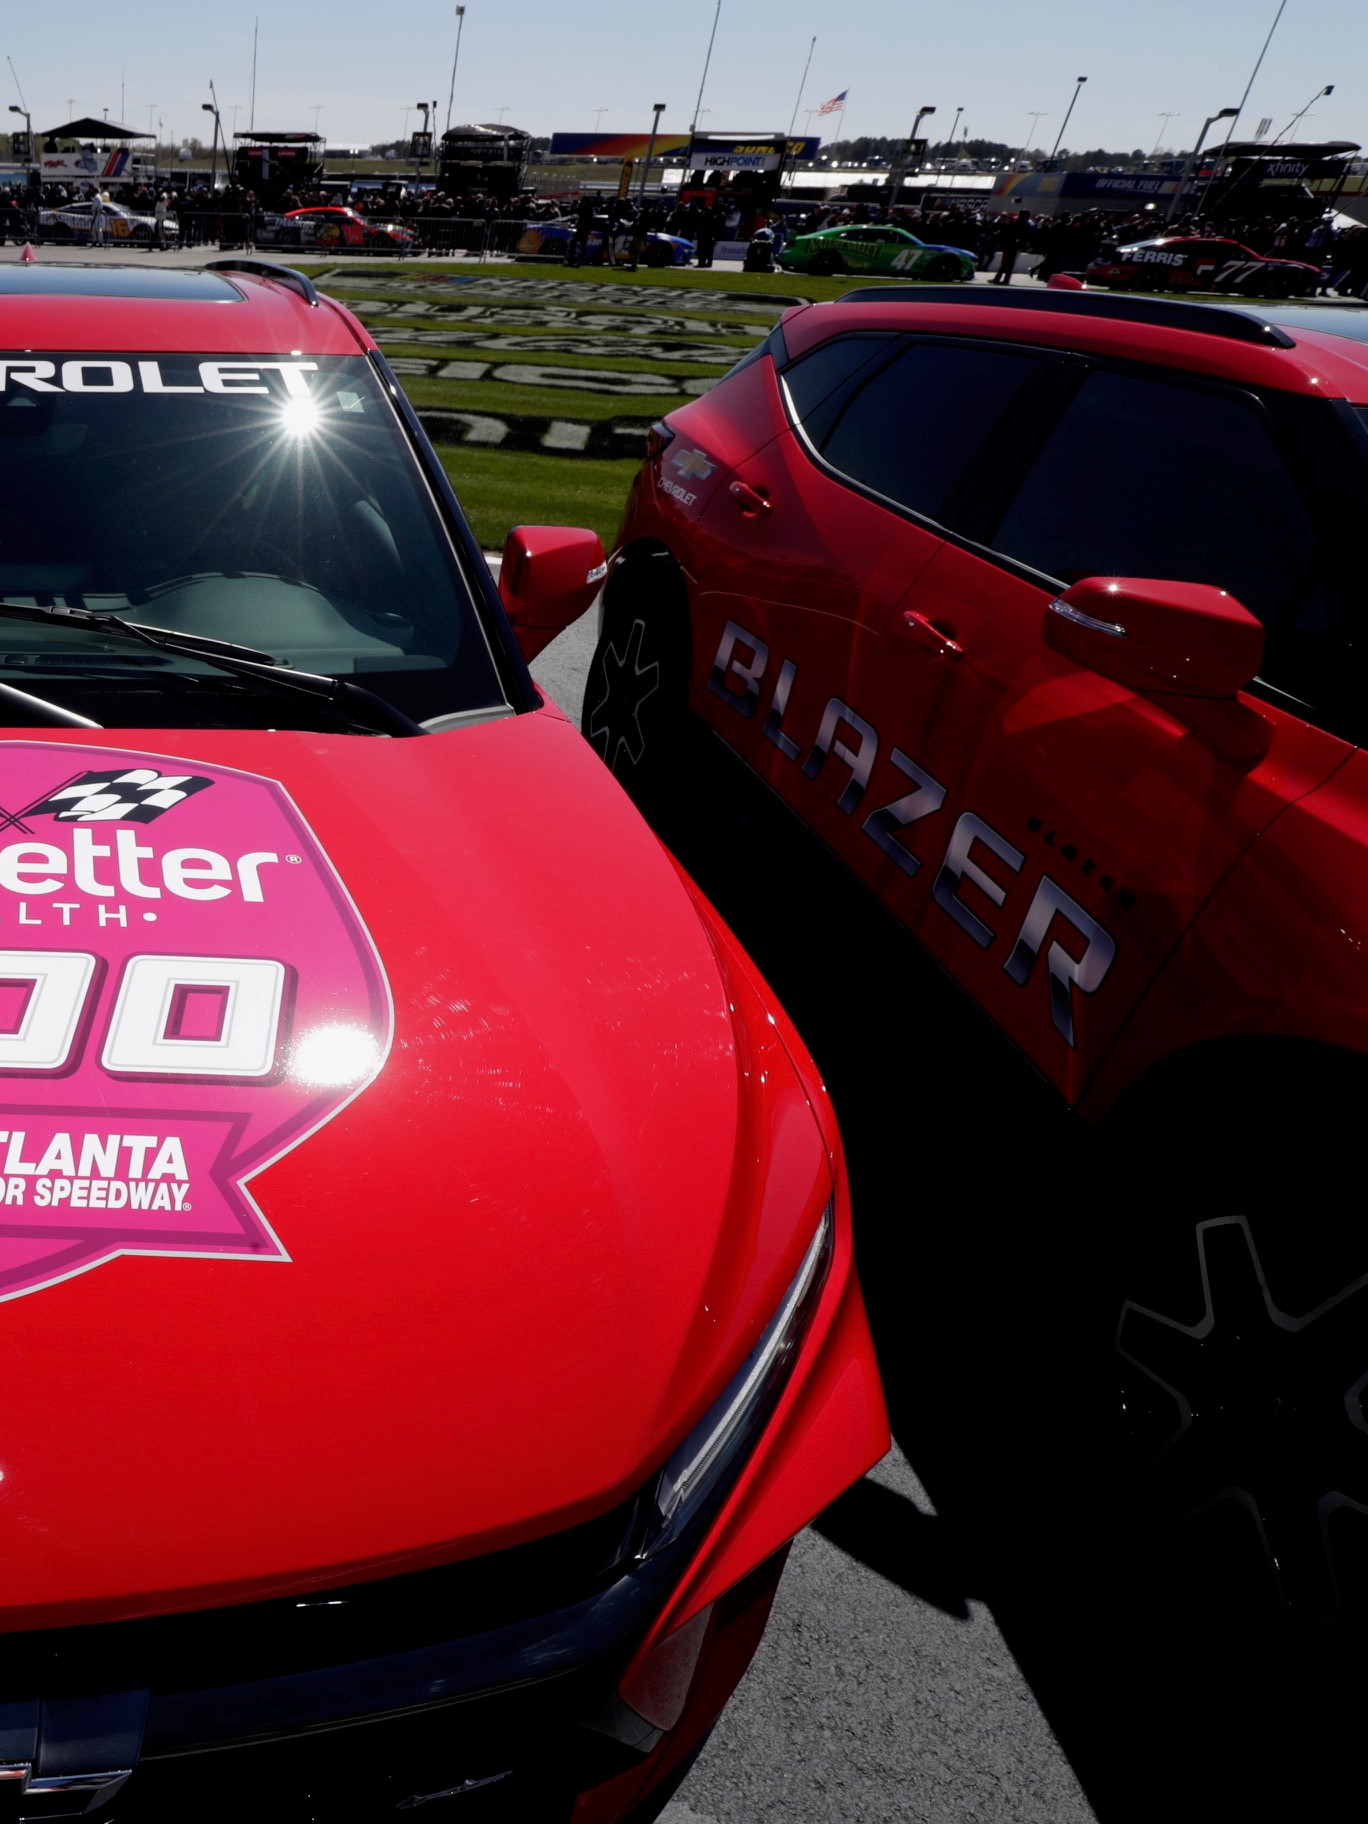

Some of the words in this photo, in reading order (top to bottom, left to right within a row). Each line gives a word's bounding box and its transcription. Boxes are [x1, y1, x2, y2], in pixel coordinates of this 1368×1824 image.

[1266, 161, 1310, 176] xfinity
[1120, 251, 1185, 266] FERRIS
[657, 476, 698, 506] CHEVROLET
[706, 619, 1118, 1049] BLAZER
[31, 1178, 190, 1211] SPEEDWAY
